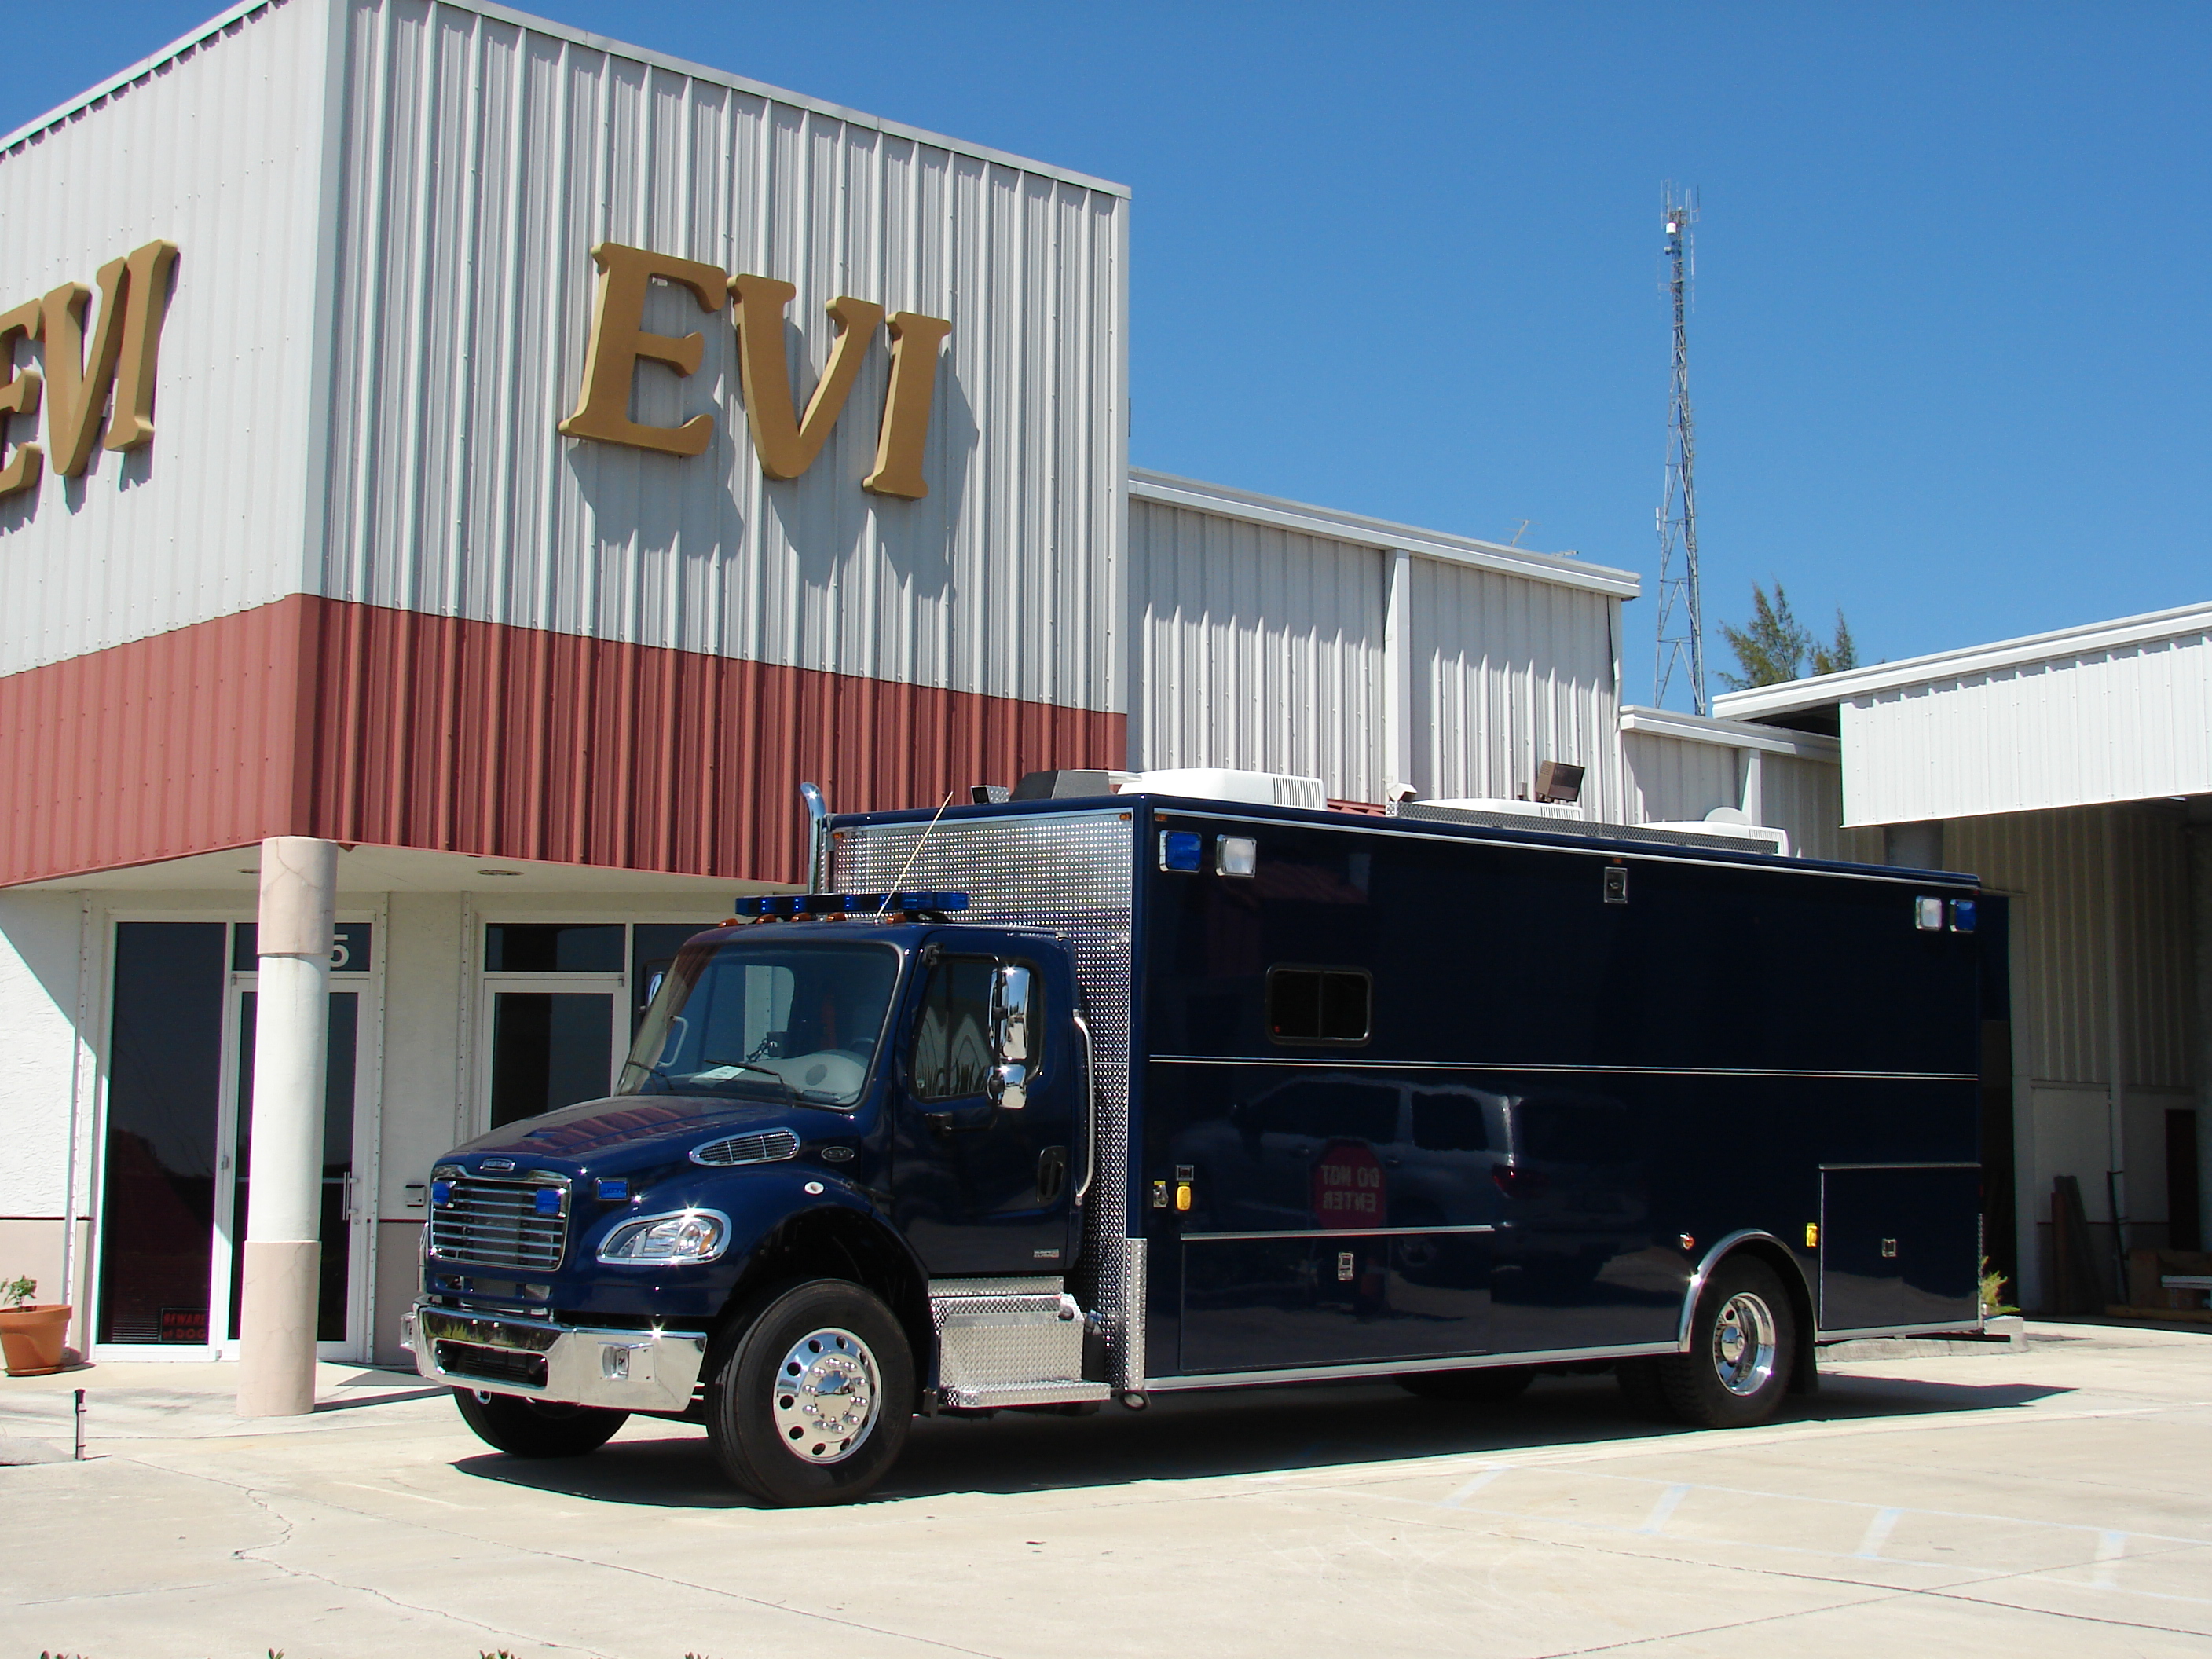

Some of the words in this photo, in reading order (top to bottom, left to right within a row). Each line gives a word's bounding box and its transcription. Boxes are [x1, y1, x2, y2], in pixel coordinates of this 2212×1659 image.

[558, 242, 952, 500] EVI
[163, 1313, 206, 1326] BEWARE
[175, 1328, 206, 1339] DOG
